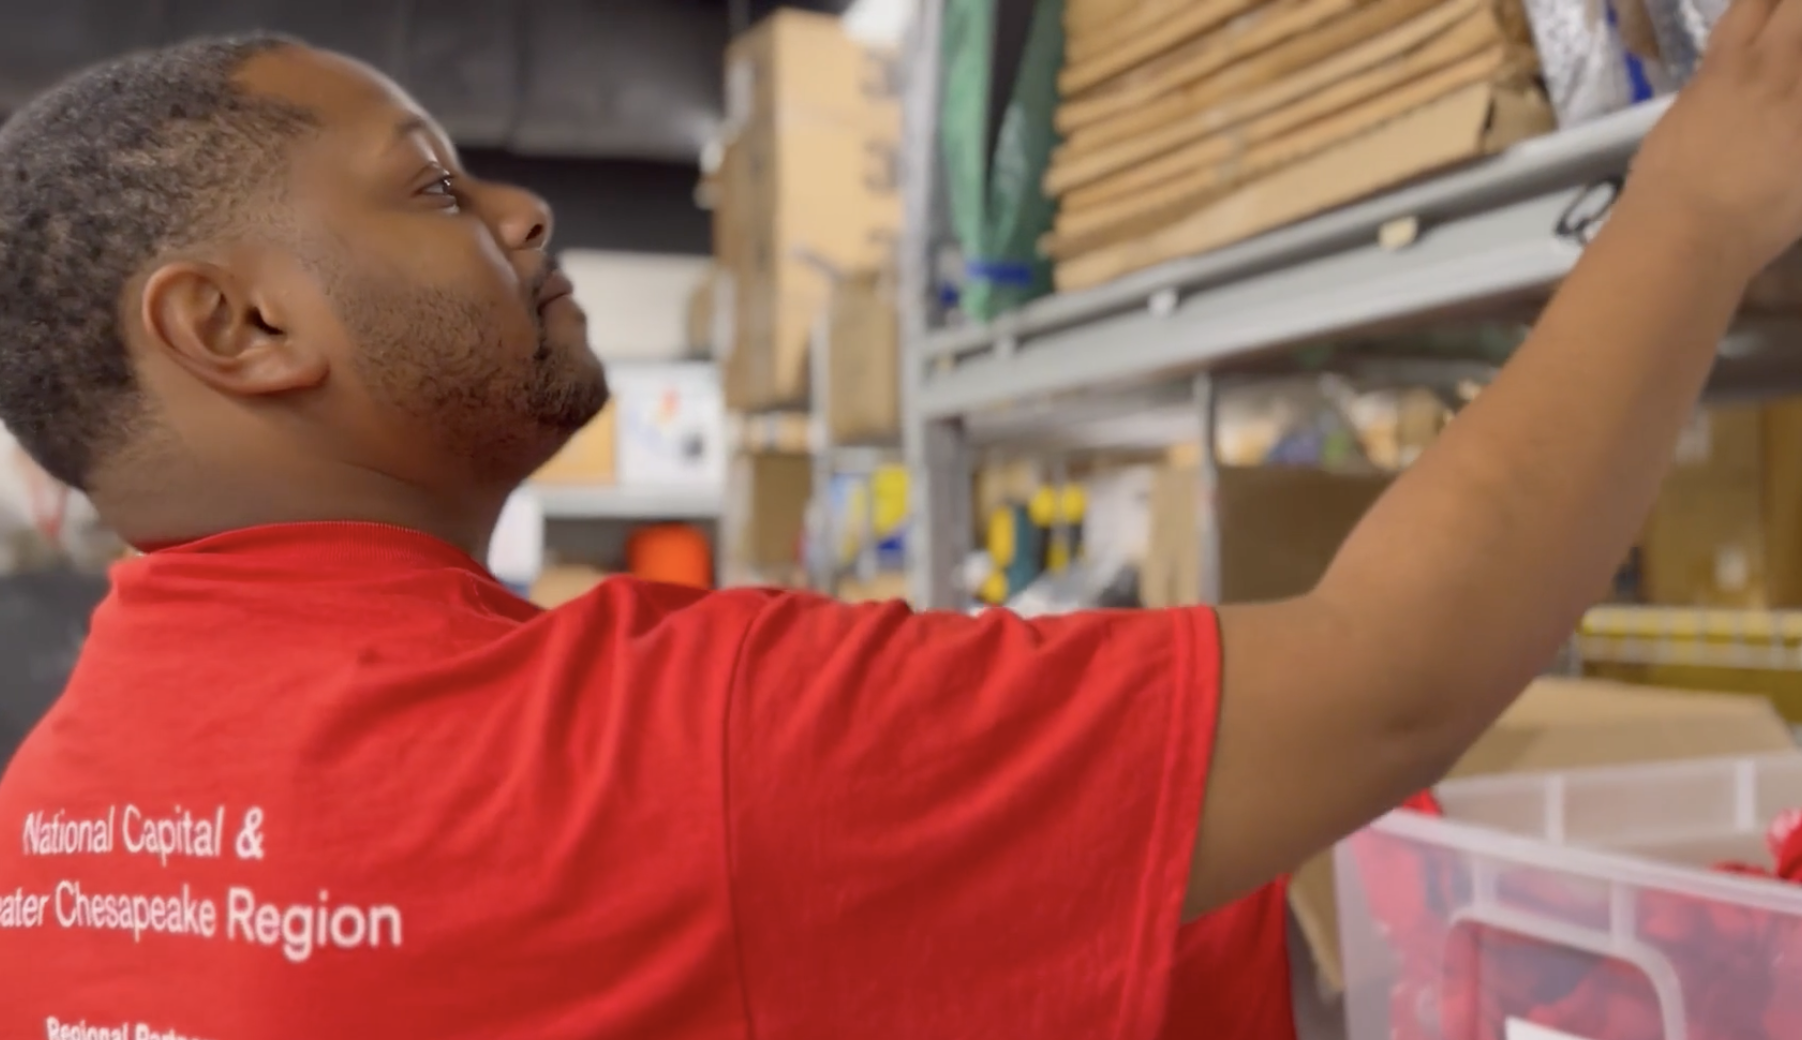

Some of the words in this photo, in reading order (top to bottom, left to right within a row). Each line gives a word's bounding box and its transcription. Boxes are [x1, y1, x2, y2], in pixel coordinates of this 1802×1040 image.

[22, 805, 116, 856] National
[121, 803, 225, 867] Capital
[234, 806, 266, 860] &
[0, 887, 51, 928] ater
[54, 879, 217, 942] Chesapeake
[226, 886, 403, 963] Region
